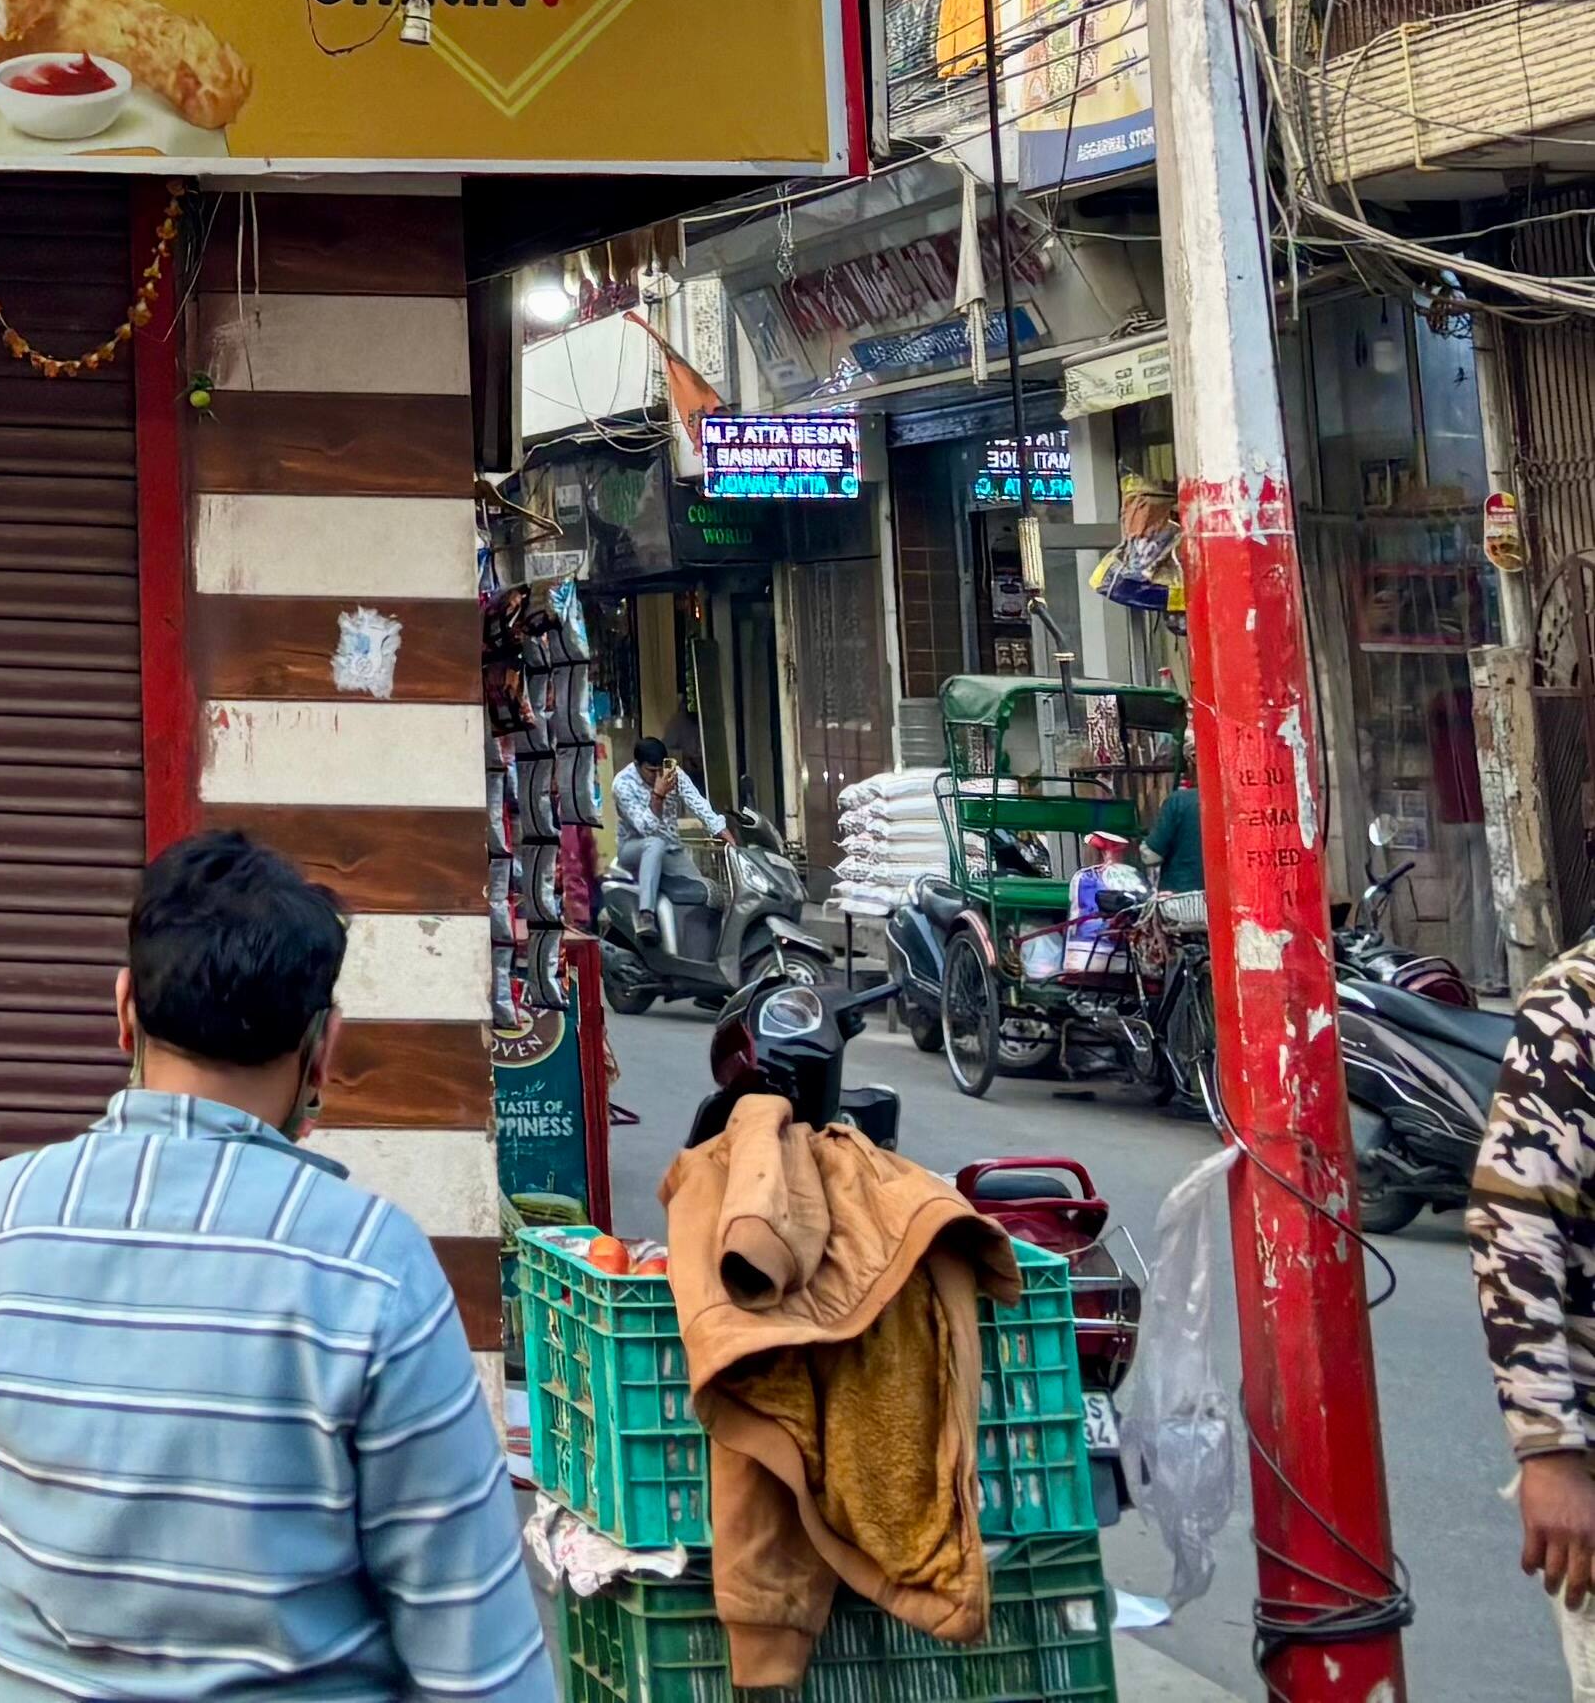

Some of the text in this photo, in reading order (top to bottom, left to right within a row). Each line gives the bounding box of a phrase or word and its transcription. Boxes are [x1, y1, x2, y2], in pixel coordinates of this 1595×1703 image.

[792, 425, 855, 445] BESAN
[716, 448, 843, 468] BASMATI RICE
[499, 1100, 563, 1115] TASTE OF
